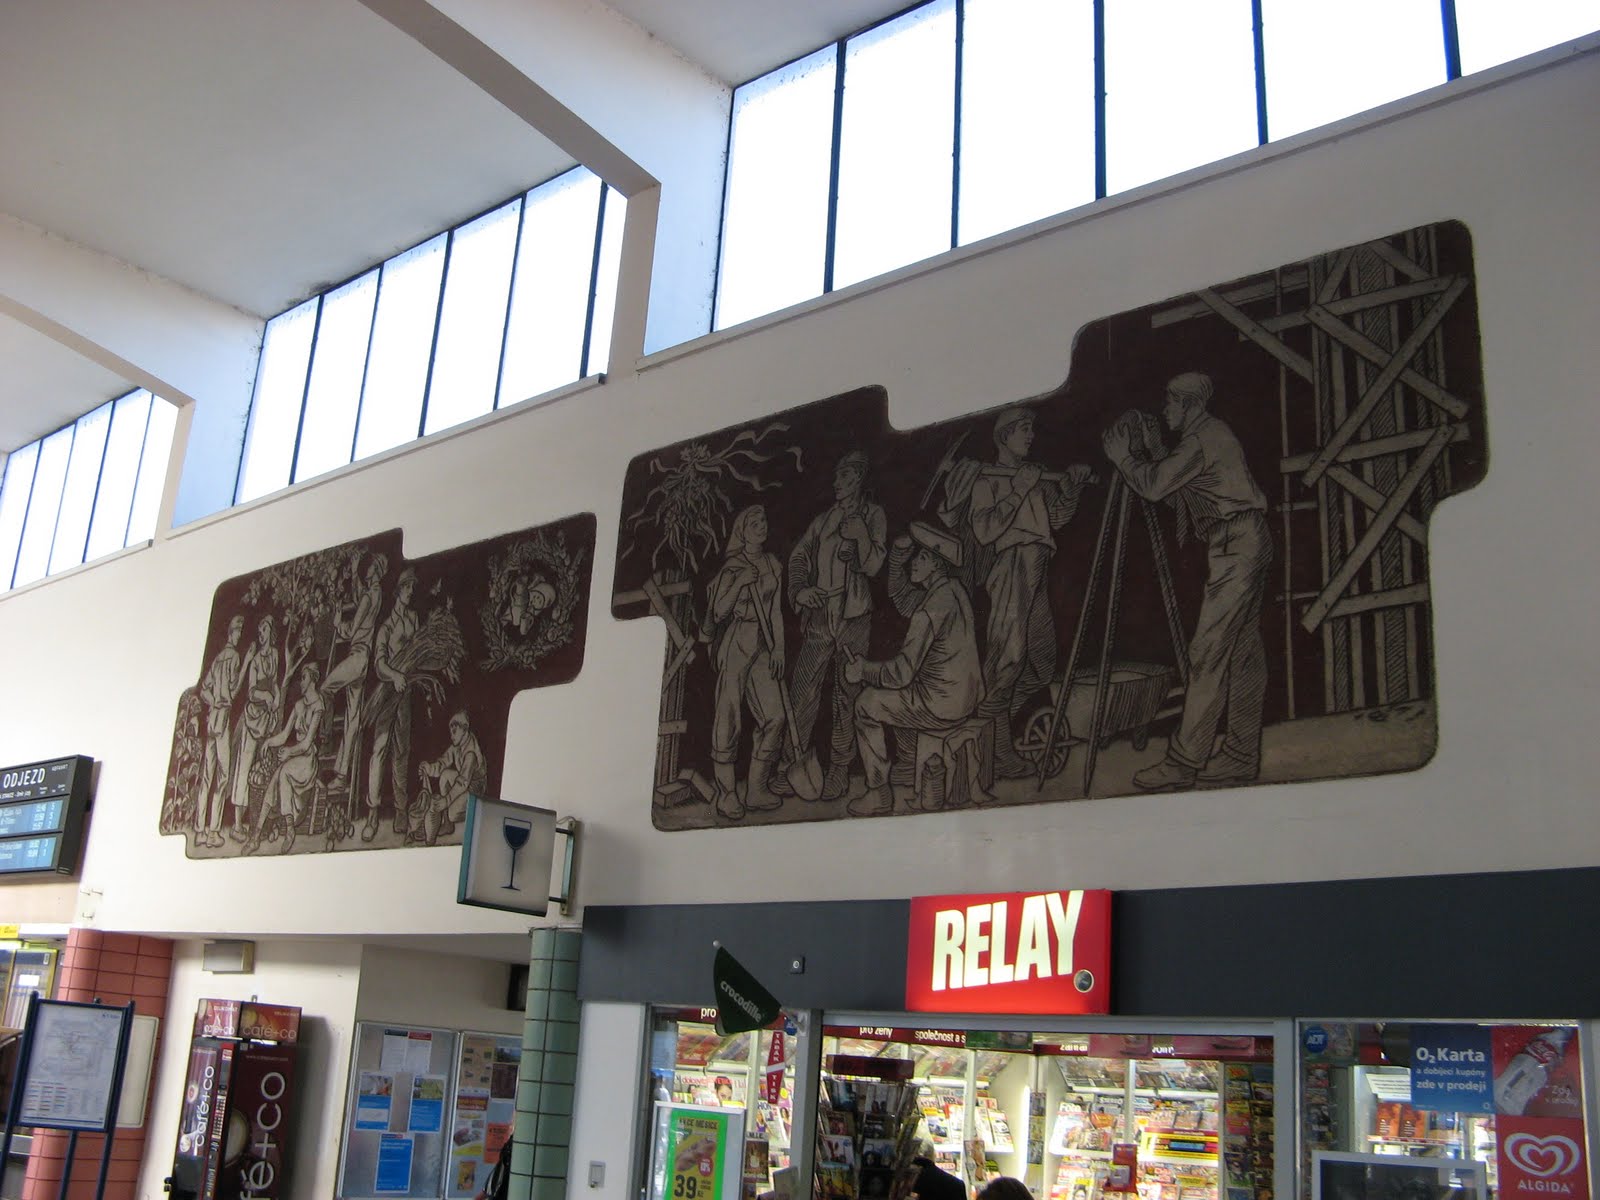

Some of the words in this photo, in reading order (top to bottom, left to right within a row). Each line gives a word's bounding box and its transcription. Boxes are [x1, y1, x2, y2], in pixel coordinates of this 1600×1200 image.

[3, 767, 46, 789] ODJEZD
[931, 890, 1084, 991] RELAY
[720, 980, 762, 1023] crocodille
[700, 1007, 717, 1020] pro
[242, 1023, 297, 1040] café+co
[1306, 1034, 1325, 1045] ADT
[1437, 1047, 1486, 1062] Karta
[1416, 1080, 1436, 1089] zde
[1437, 1081, 1445, 1089] v
[1446, 1081, 1487, 1093] prodeji
[195, 1066, 214, 1147] café+co
[674, 1174, 697, 1199] 39
[1517, 1179, 1571, 1194] ALGIDA
